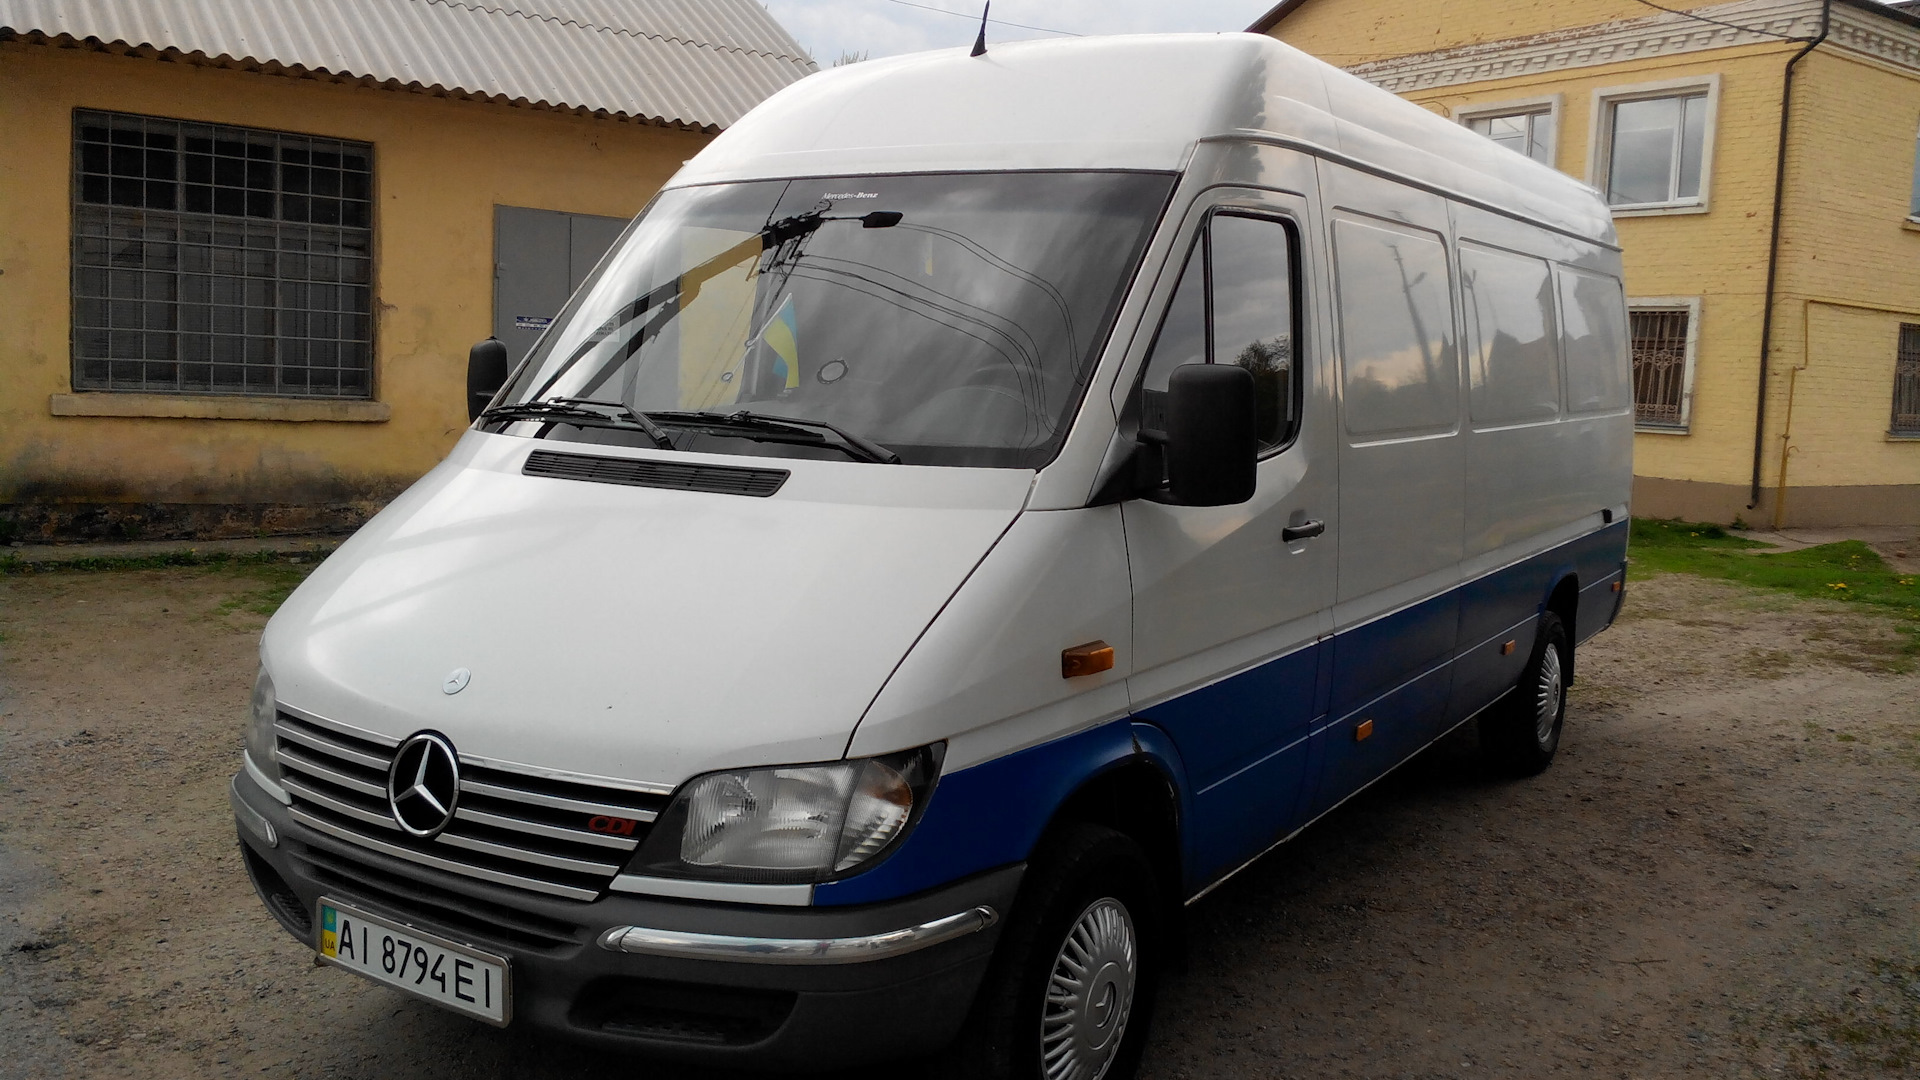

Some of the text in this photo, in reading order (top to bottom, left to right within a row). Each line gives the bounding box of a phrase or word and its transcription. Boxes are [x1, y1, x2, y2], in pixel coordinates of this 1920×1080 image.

[821, 191, 879, 200] Mercedes-Benz
[588, 815, 637, 836] CDI
[324, 938, 336, 951] UA
